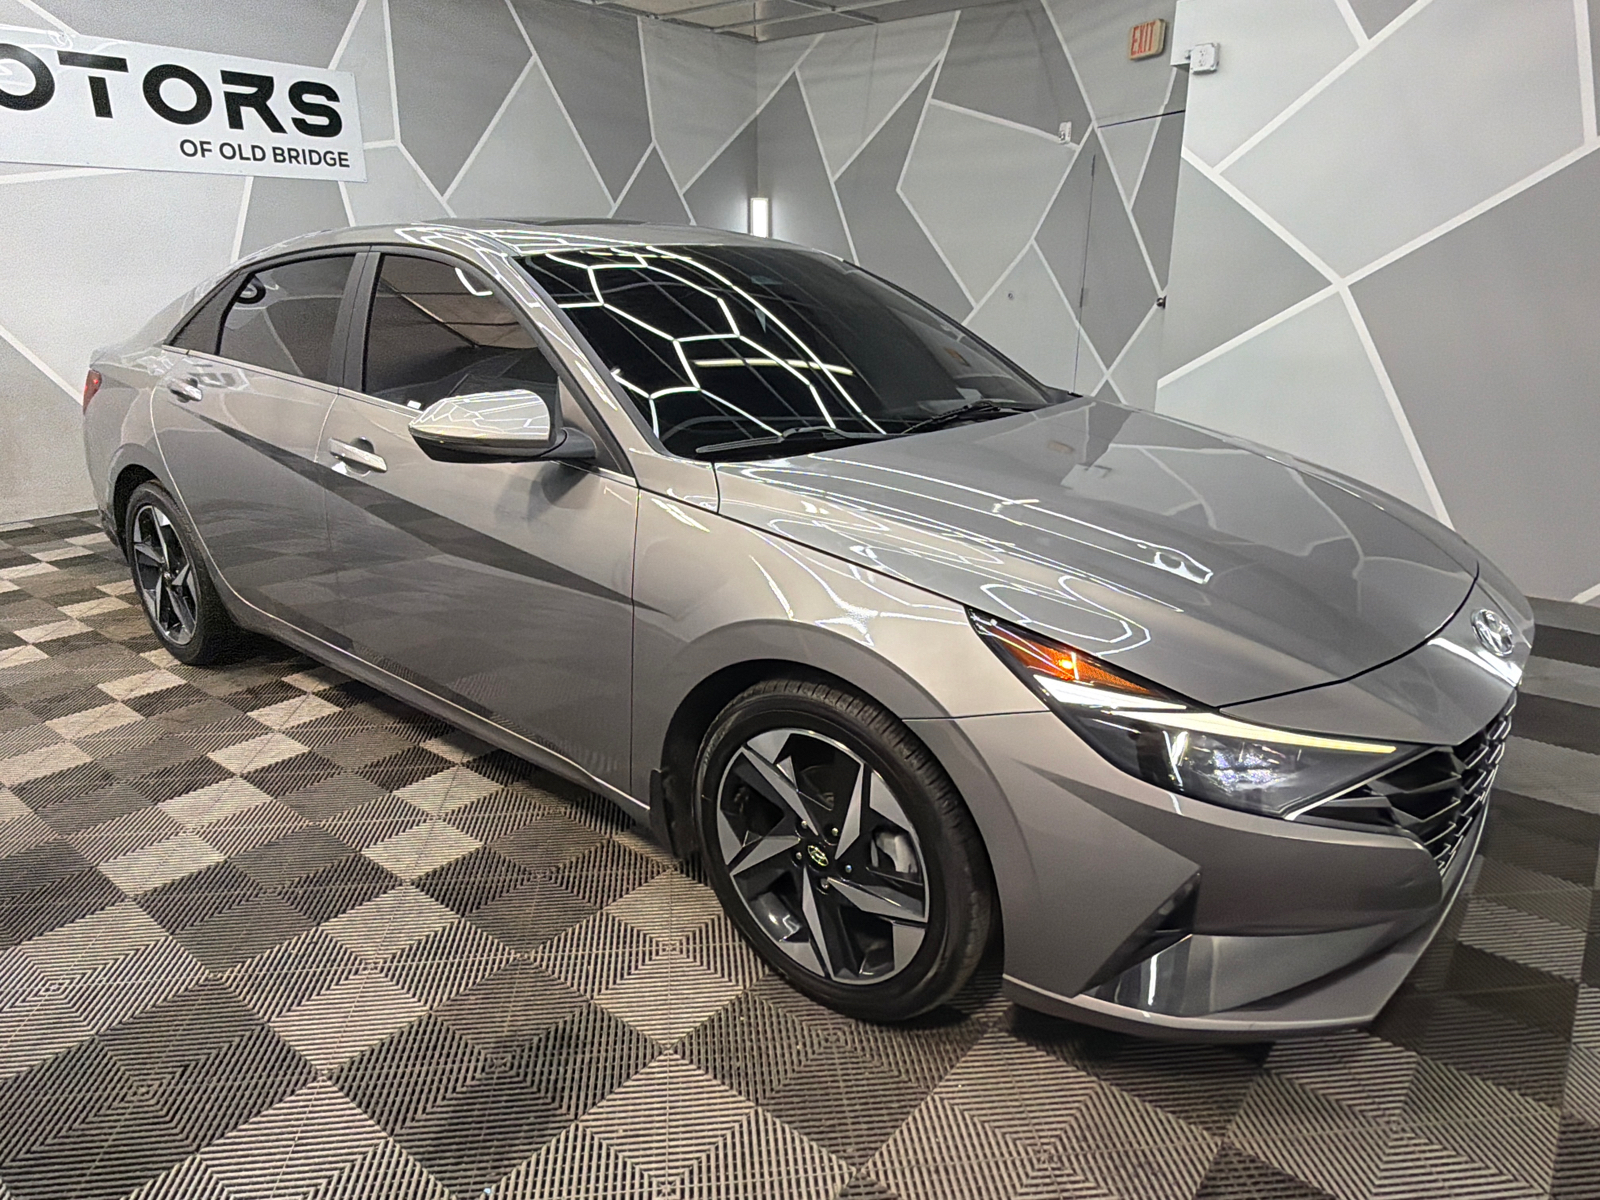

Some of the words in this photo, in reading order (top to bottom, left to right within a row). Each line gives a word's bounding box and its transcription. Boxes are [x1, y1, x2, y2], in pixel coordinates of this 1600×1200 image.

[1130, 20, 1156, 56] EXIT
[179, 139, 213, 158] OF
[219, 142, 266, 162] OLD
[272, 146, 350, 168] BRIDGE
